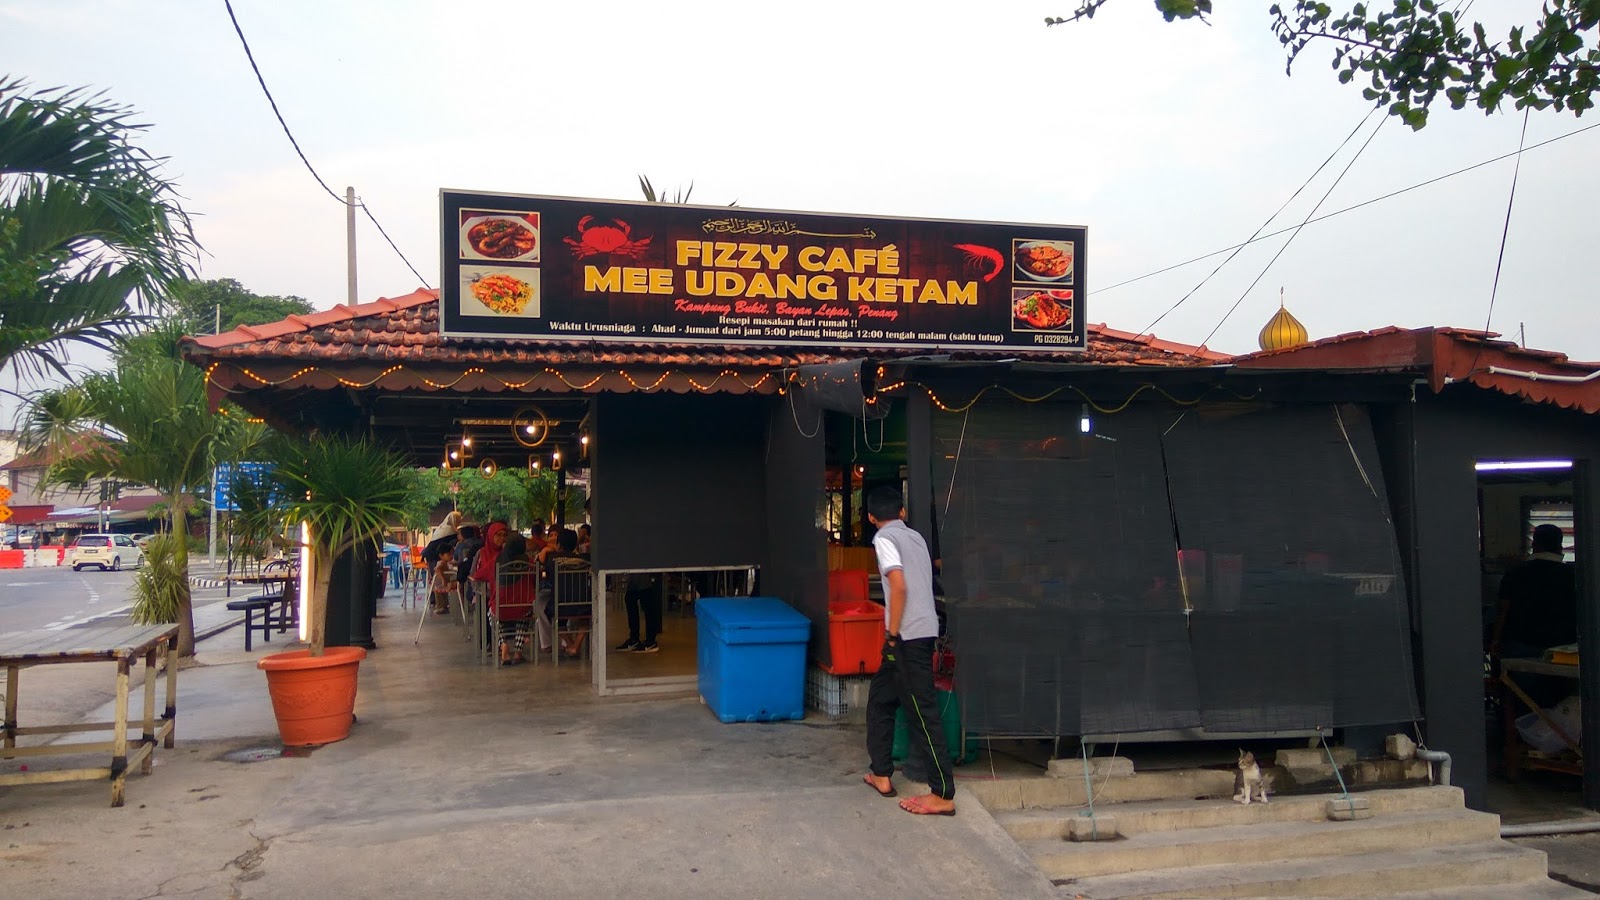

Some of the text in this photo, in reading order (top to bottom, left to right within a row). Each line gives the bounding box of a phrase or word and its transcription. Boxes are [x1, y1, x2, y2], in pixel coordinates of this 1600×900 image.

[676, 240, 900, 275] FIZZY CAFÉ
[584, 265, 978, 305] MEE UDANG KETAM
[674, 299, 732, 315] Kampung
[775, 302, 813, 318] Bayan
[814, 303, 853, 318] Lepas,
[857, 304, 899, 321] Penang
[549, 321, 582, 331] Waktu
[584, 322, 636, 334] Urusniaga
[651, 324, 676, 333] Ahad
[684, 324, 720, 335] Jumaat
[721, 326, 742, 336] dari
[743, 327, 762, 337] jam
[764, 327, 787, 337] 5:00
[789, 328, 821, 338] petang
[822, 328, 854, 339] hingga
[856, 329, 884, 339] 12:00
[885, 331, 916, 341] tengah
[917, 332, 947, 341] malam
[949, 332, 977, 342] (sabtu
[978, 333, 1004, 343] tutup)
[718, 315, 750, 326] Resepi
[752, 317, 795, 327] masakan
[796, 318, 816, 327] dari
[818, 319, 848, 328] rumah
[1034, 334, 1043, 344] PG
